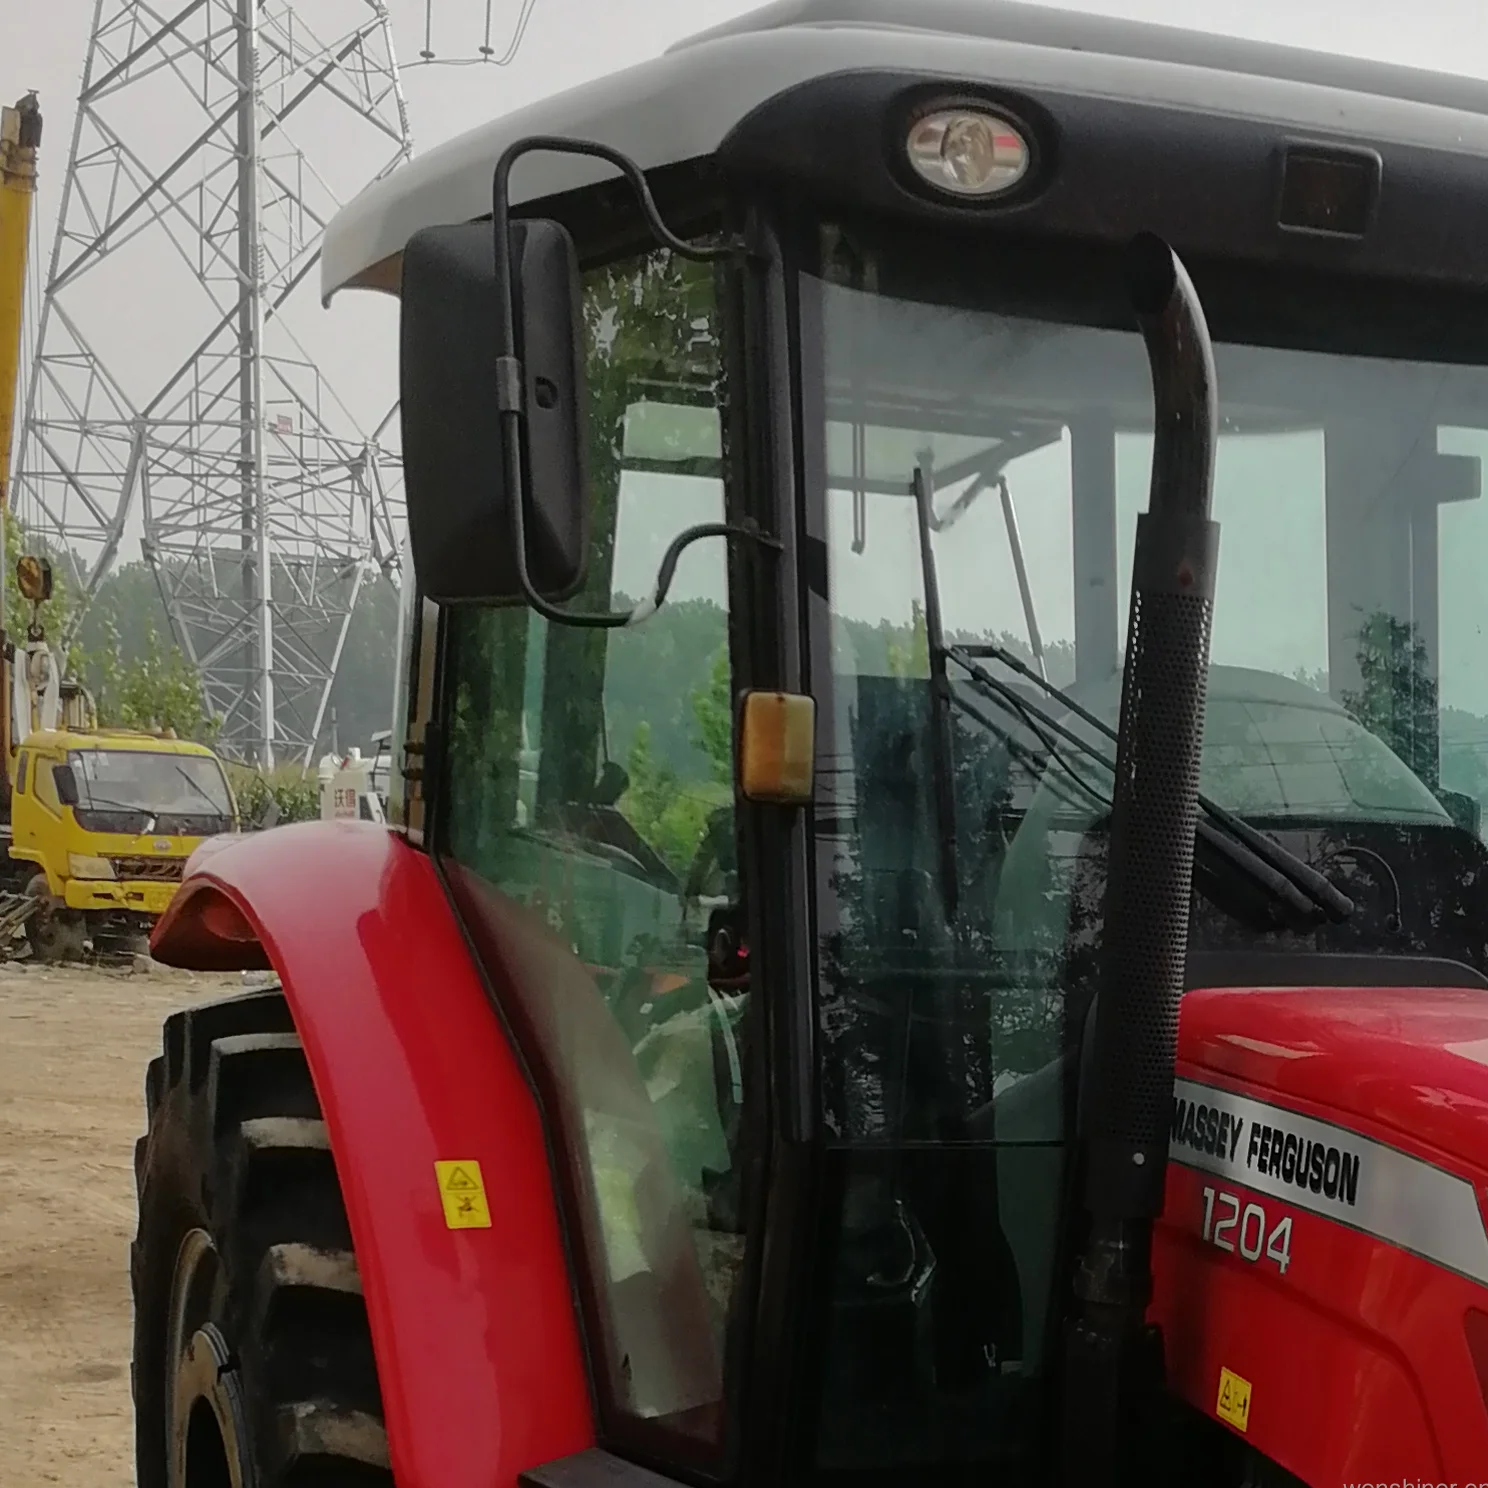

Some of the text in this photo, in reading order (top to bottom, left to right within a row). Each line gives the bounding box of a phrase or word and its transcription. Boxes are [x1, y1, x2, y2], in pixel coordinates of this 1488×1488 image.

[1170, 1097, 1360, 1206] MASSEY FERGUSON
[1203, 1187, 1293, 1275] 1204
